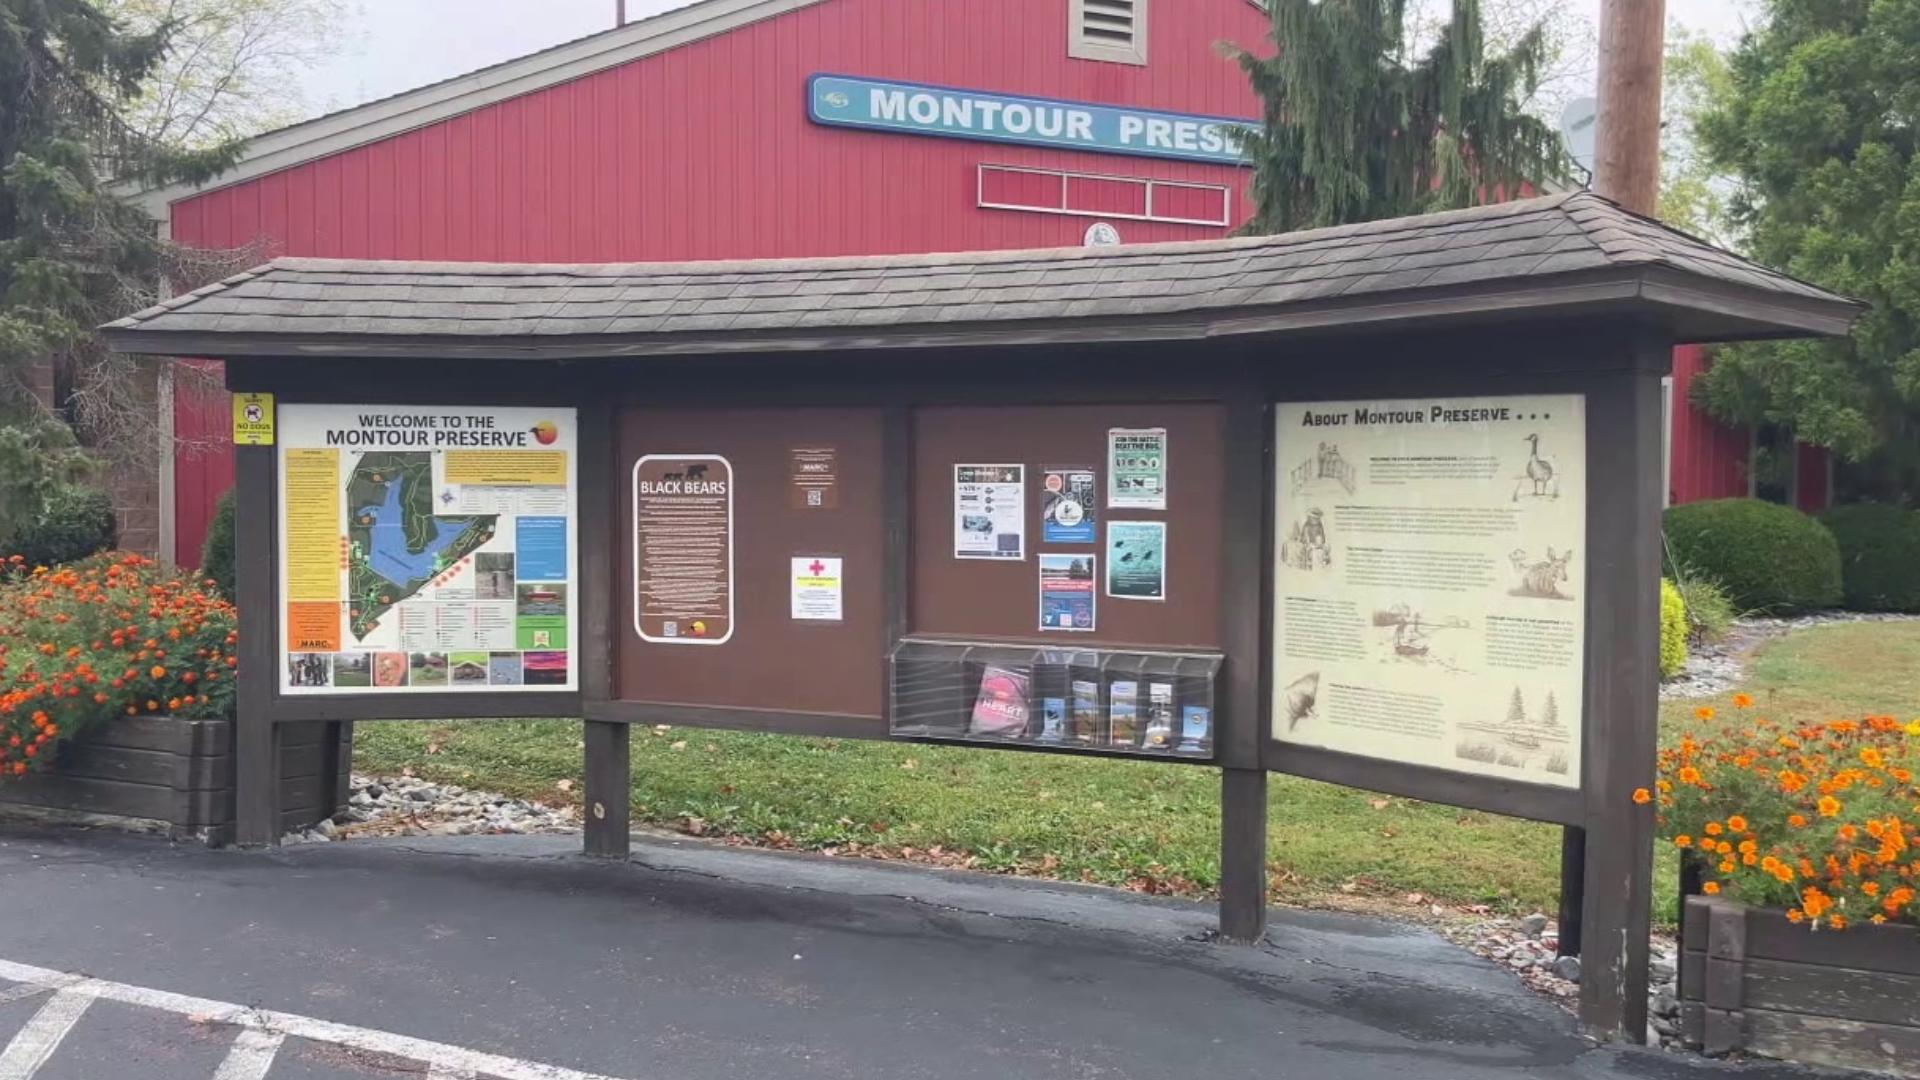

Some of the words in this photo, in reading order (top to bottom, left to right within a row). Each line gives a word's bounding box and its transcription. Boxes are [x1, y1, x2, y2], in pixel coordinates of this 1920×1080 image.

[870, 89, 1094, 140] MONTOUR
[359, 415, 437, 428] WELCOME
[442, 416, 461, 428] TO
[465, 416, 494, 428] THE
[326, 430, 428, 446] MONTOUR
[435, 431, 527, 447] PRESERVE
[641, 481, 681, 493] BLACK
[684, 481, 726, 494] BEARS
